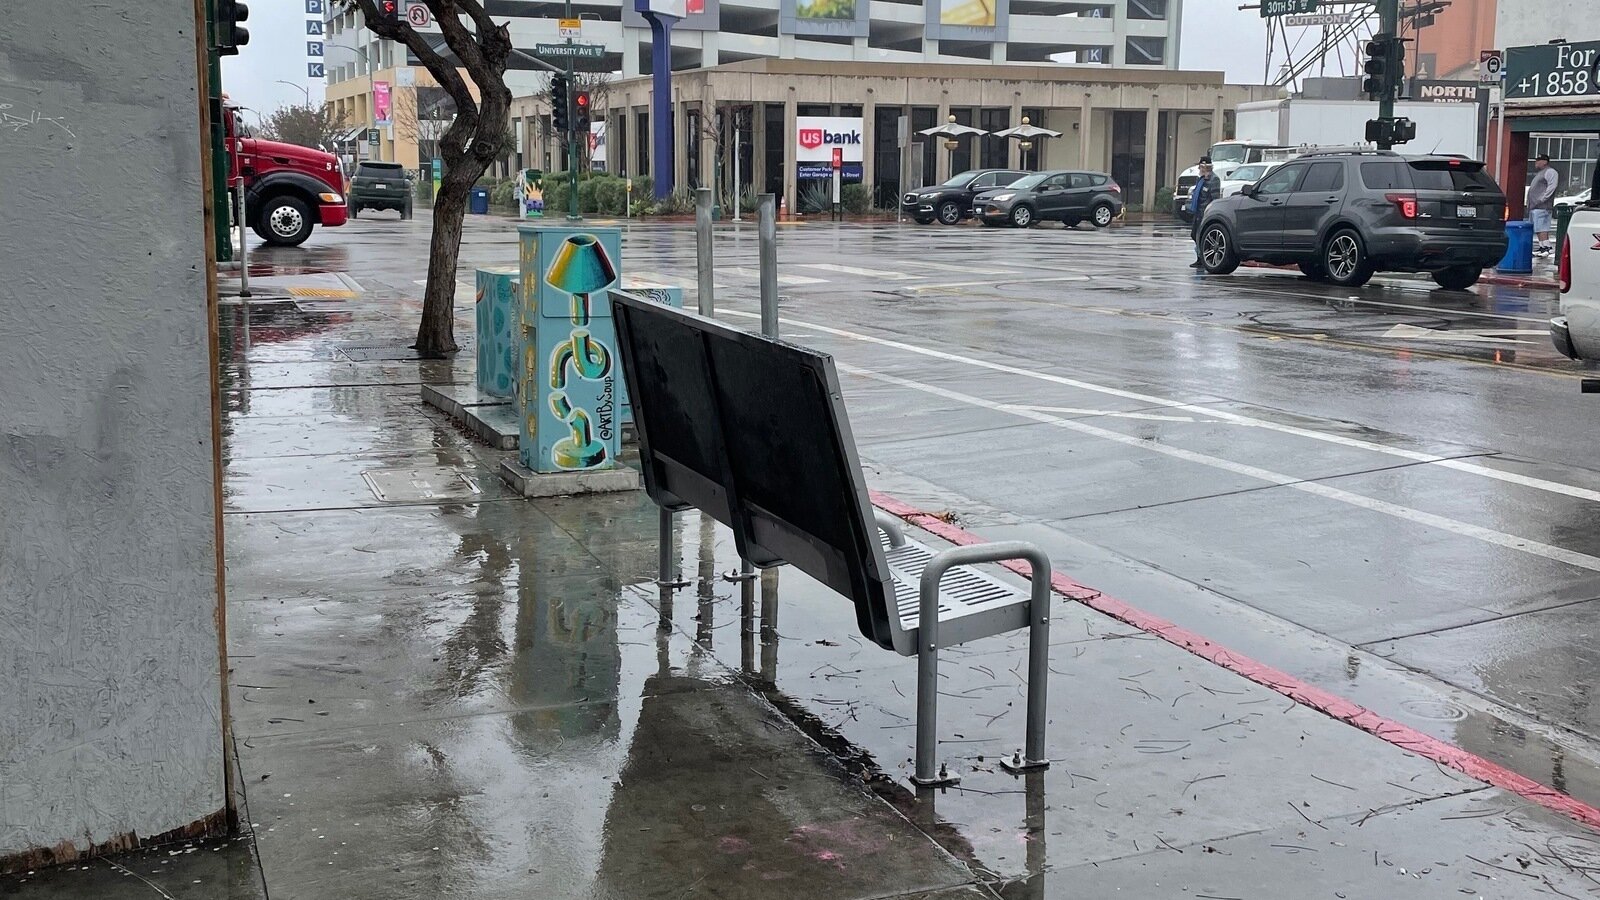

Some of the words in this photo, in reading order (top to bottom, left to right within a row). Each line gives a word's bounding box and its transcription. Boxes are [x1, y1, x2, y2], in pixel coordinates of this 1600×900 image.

[1267, 2, 1286, 14] 30TH
[1287, 0, 1296, 11] ST
[1287, 14, 1350, 26] OUTFRONT
[538, 46, 577, 55] UNIVERSITY
[578, 47, 592, 56] AVE
[1555, 45, 1595, 69] For
[1546, 70, 1589, 96] 858
[1420, 85, 1477, 99] NORTH
[823, 129, 861, 144] bank
